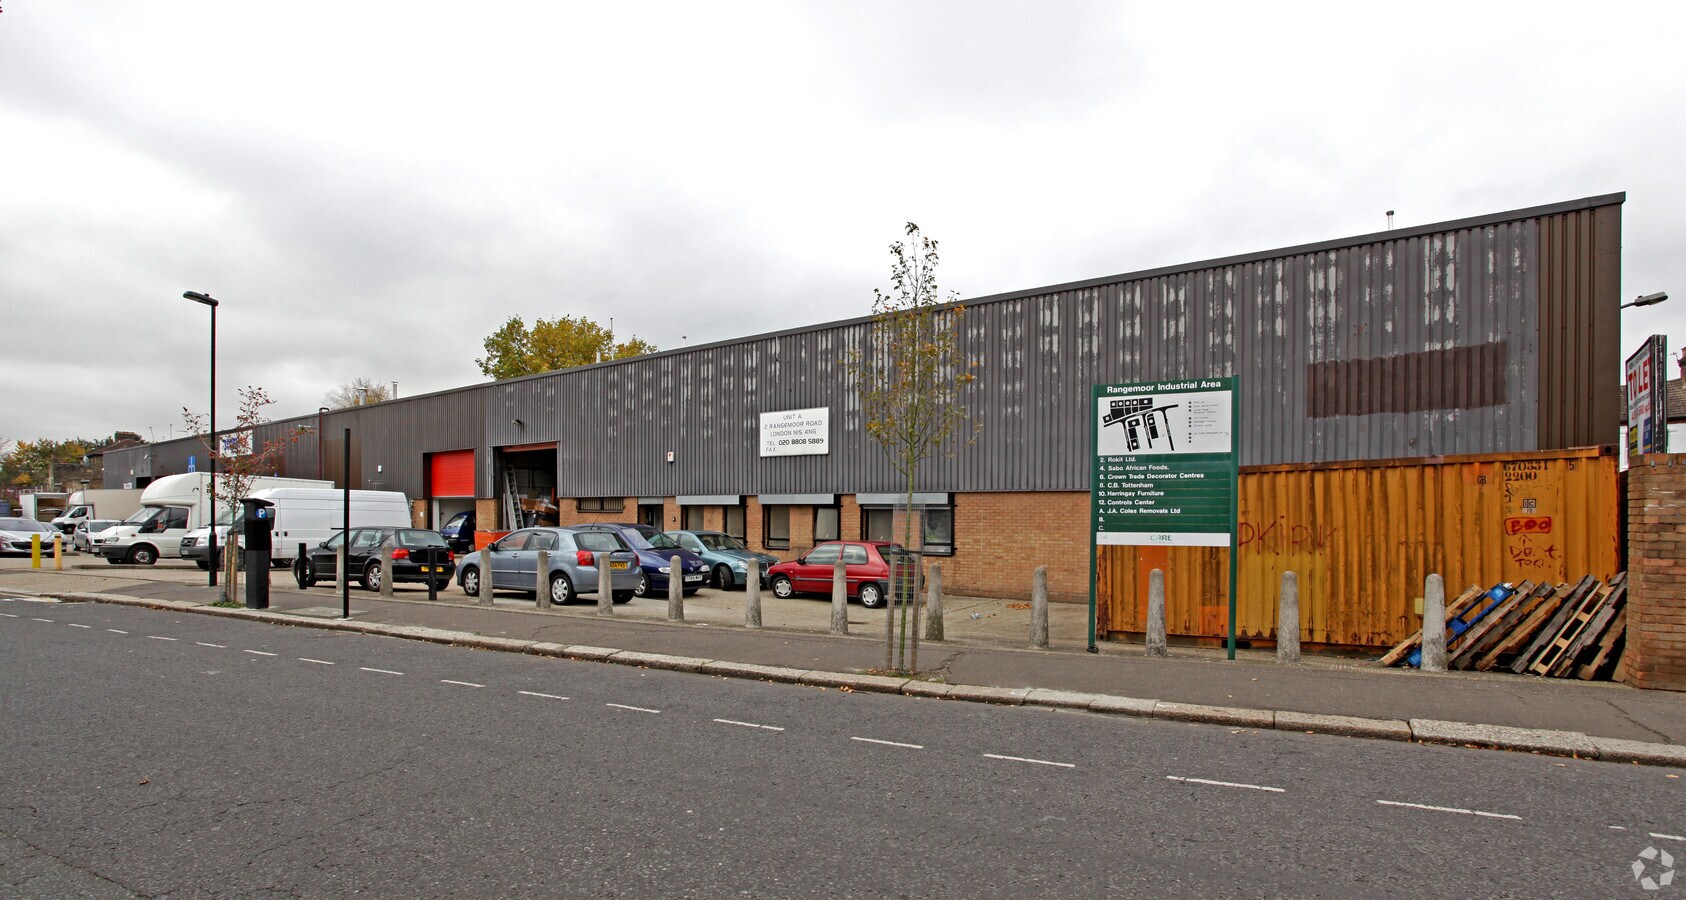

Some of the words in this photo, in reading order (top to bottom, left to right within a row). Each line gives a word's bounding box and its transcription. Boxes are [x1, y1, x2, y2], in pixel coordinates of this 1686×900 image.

[1107, 385, 1154, 394] Rangemoor
[1158, 382, 1197, 390] Industrial
[1569, 460, 1575, 470] 5
[1505, 471, 1537, 481] 2200
